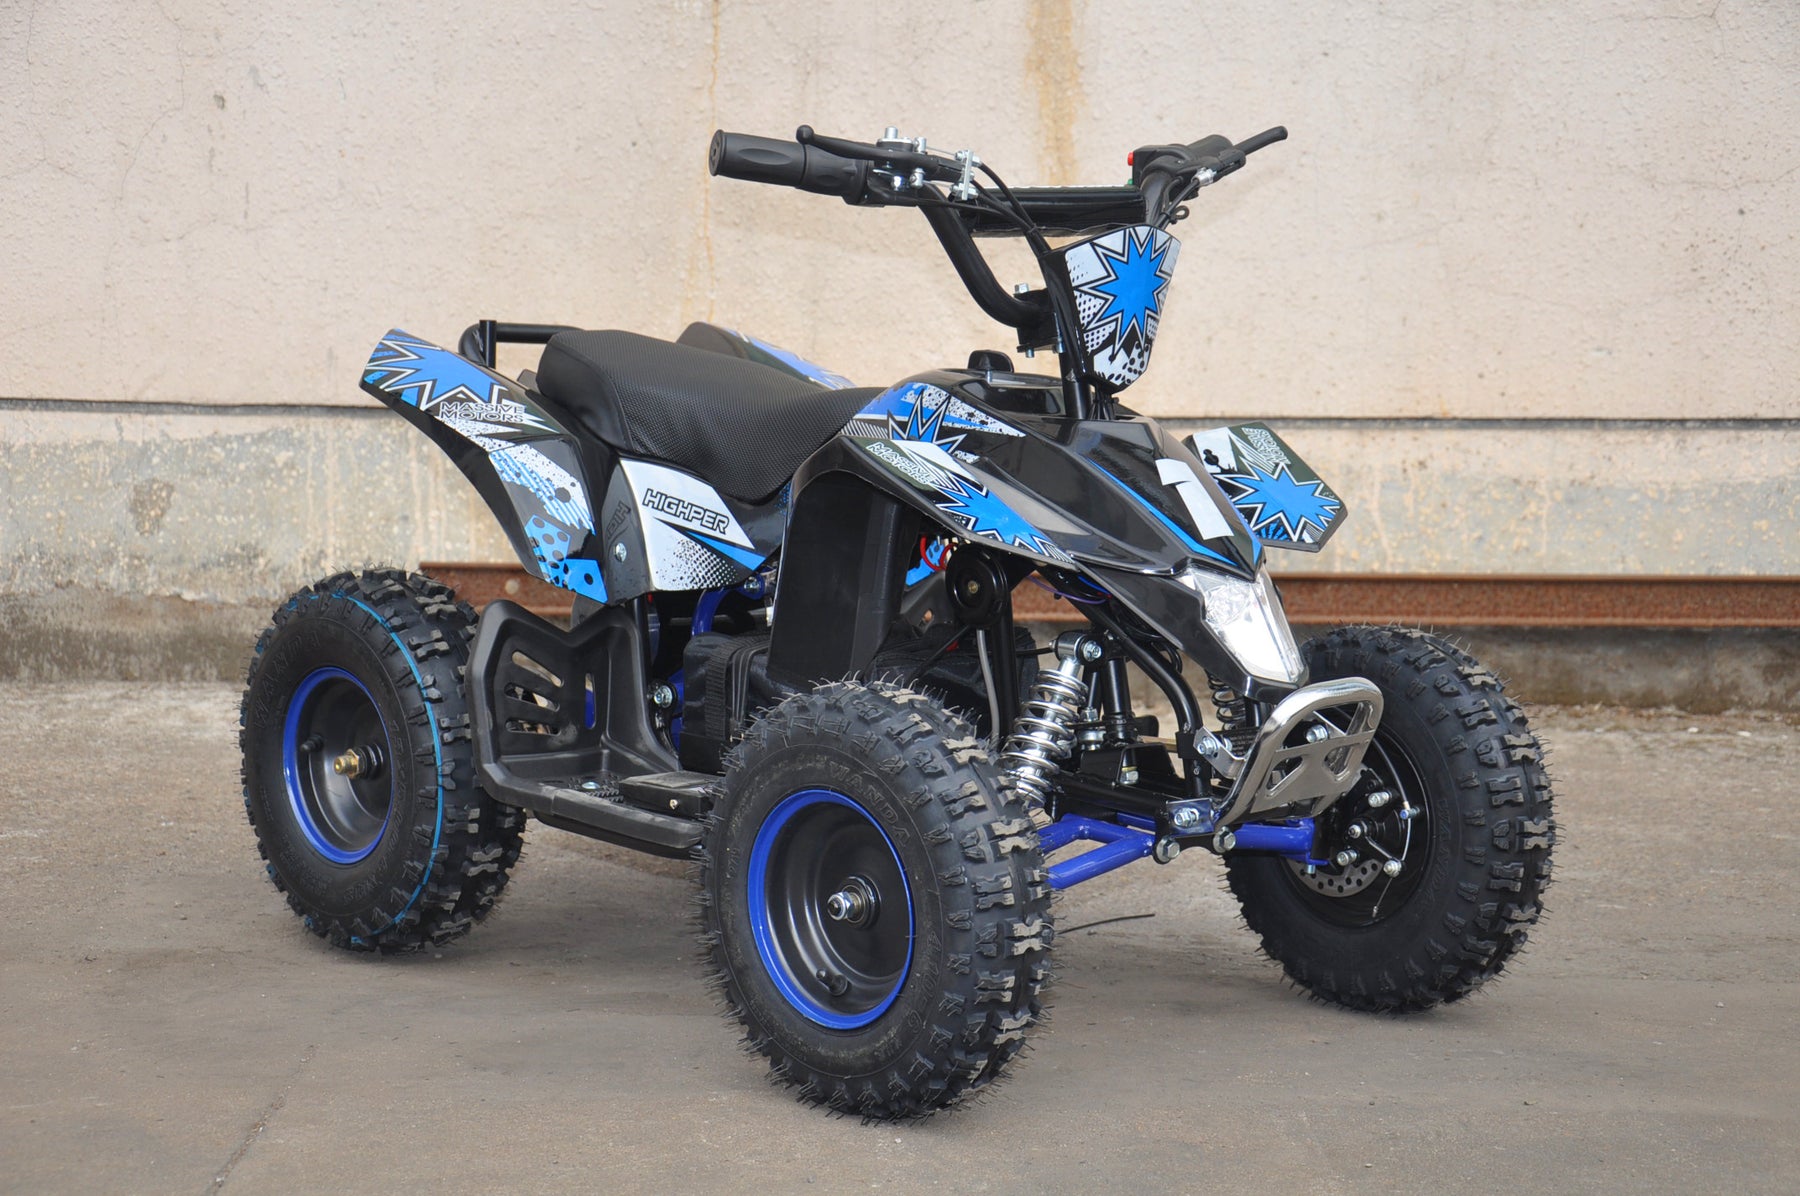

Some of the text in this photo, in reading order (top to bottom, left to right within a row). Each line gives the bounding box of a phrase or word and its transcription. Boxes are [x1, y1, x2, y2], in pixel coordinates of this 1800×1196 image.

[439, 401, 525, 414] MASSIVE
[439, 410, 524, 423] MOTORS
[866, 445, 930, 485] MOTORS
[872, 441, 936, 482] MASSIVE
[642, 488, 730, 535] HIGHPER
[829, 760, 911, 847] WANDA
